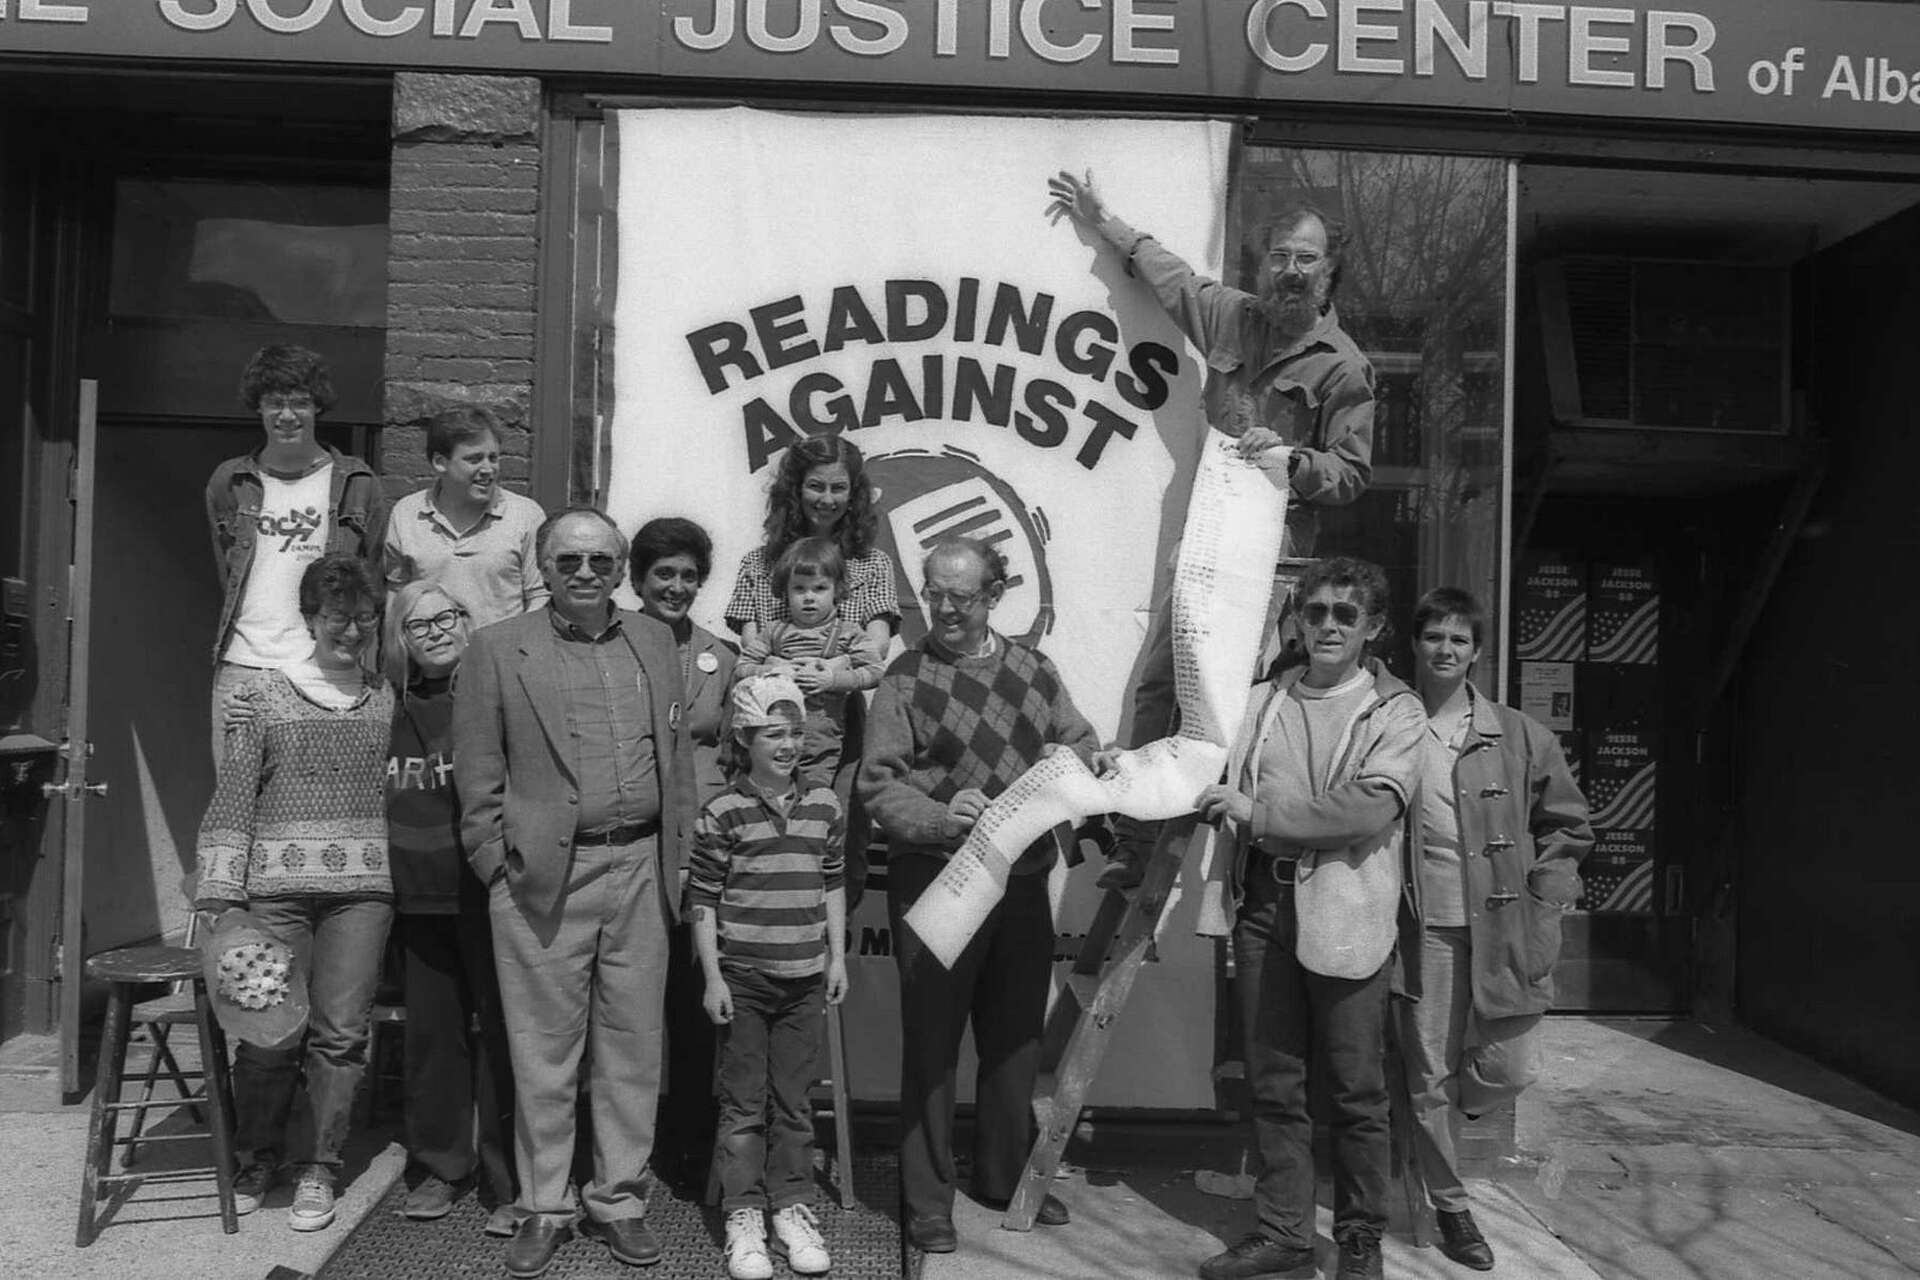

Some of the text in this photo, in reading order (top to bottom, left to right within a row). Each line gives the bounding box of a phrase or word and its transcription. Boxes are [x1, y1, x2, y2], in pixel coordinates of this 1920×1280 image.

[674, 0, 1179, 64] JUSTICE
[1247, 0, 1716, 91] CENTER
[1748, 47, 1805, 96] of
[686, 277, 1179, 411] READINGS
[742, 354, 1138, 473] AGAINST
[1527, 576, 1579, 587] JACKSON
[1601, 579, 1651, 590] JACKSON
[1597, 746, 1648, 756] JACKSON
[1595, 844, 1645, 854] JACKSON
